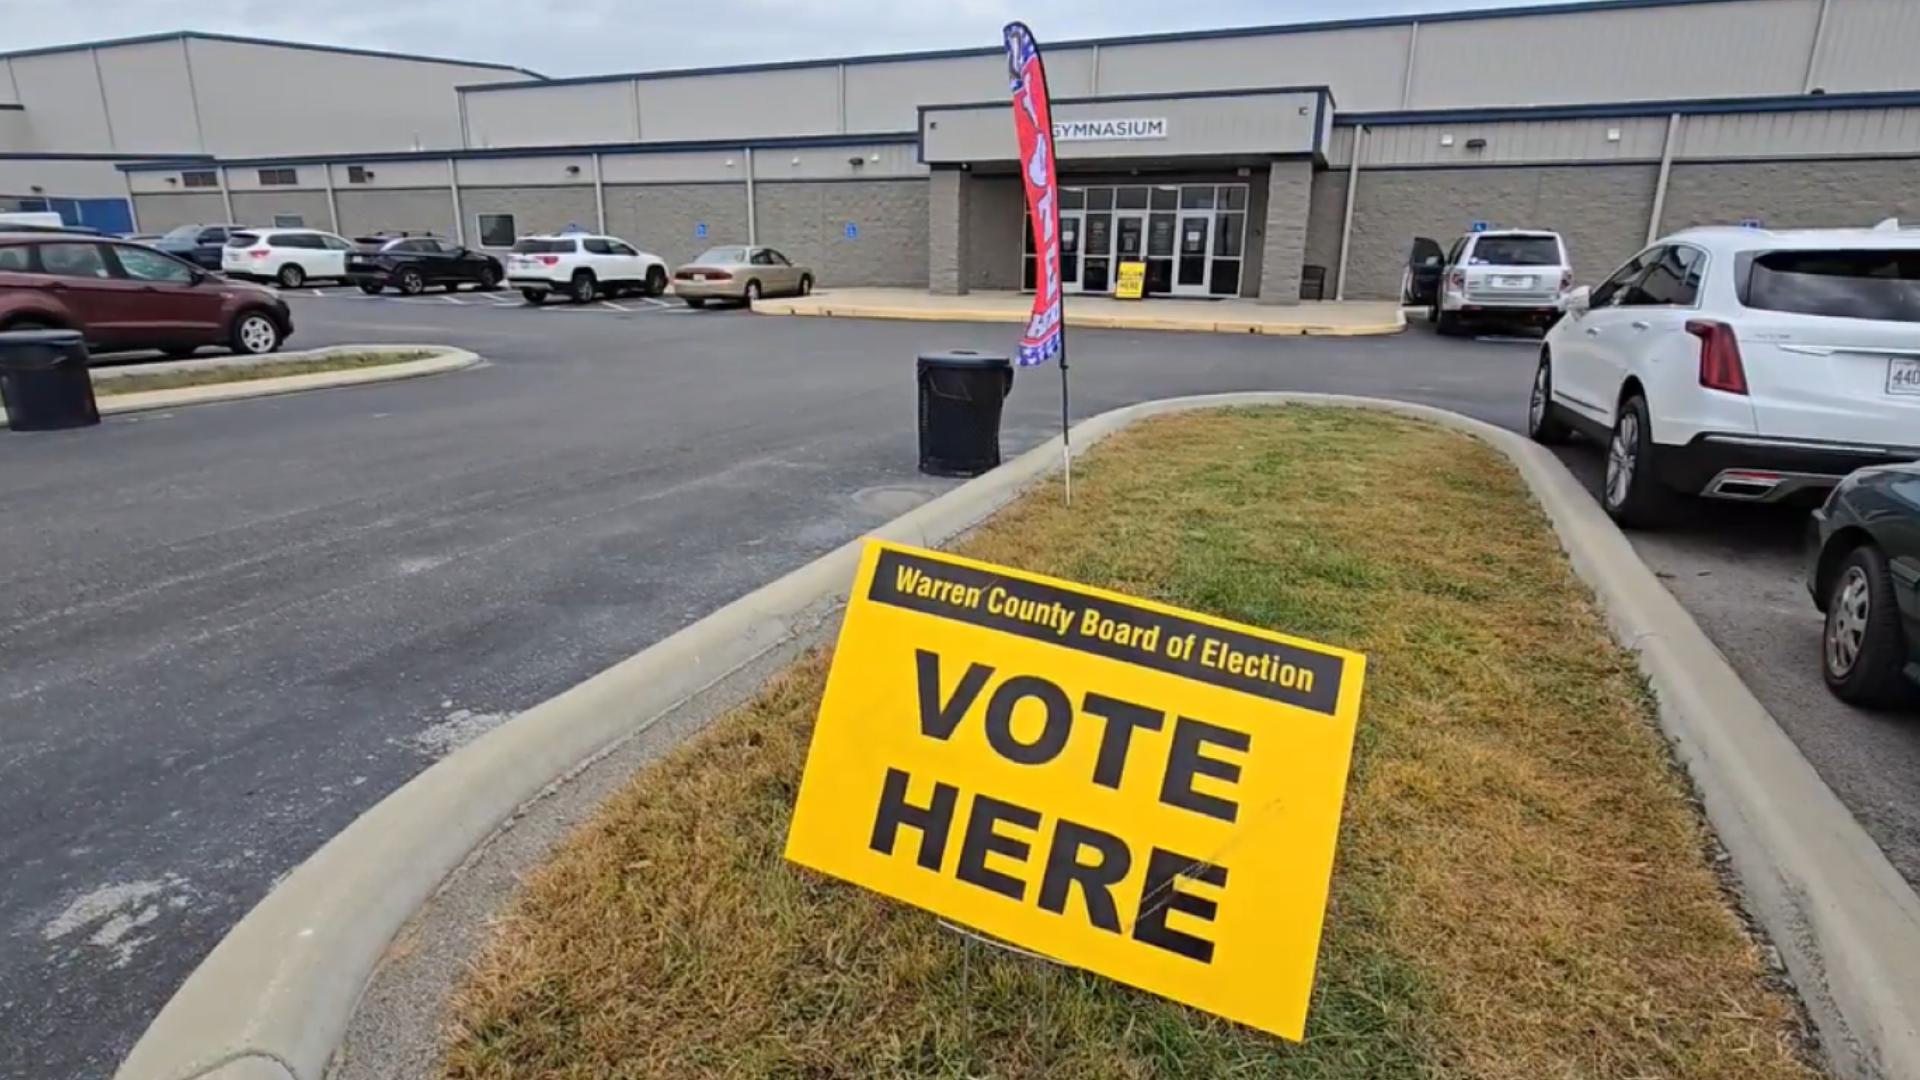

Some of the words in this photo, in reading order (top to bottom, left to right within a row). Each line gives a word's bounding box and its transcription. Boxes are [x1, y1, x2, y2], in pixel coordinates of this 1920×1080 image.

[1053, 121, 1162, 137] GYMNASIUM
[896, 564, 980, 609] Warren
[988, 588, 1075, 635] County
[1080, 610, 1159, 652] Board
[1166, 633, 1198, 661] of
[1201, 639, 1315, 693] Election
[915, 648, 1252, 824] VOTE
[868, 767, 1229, 965] HERE
